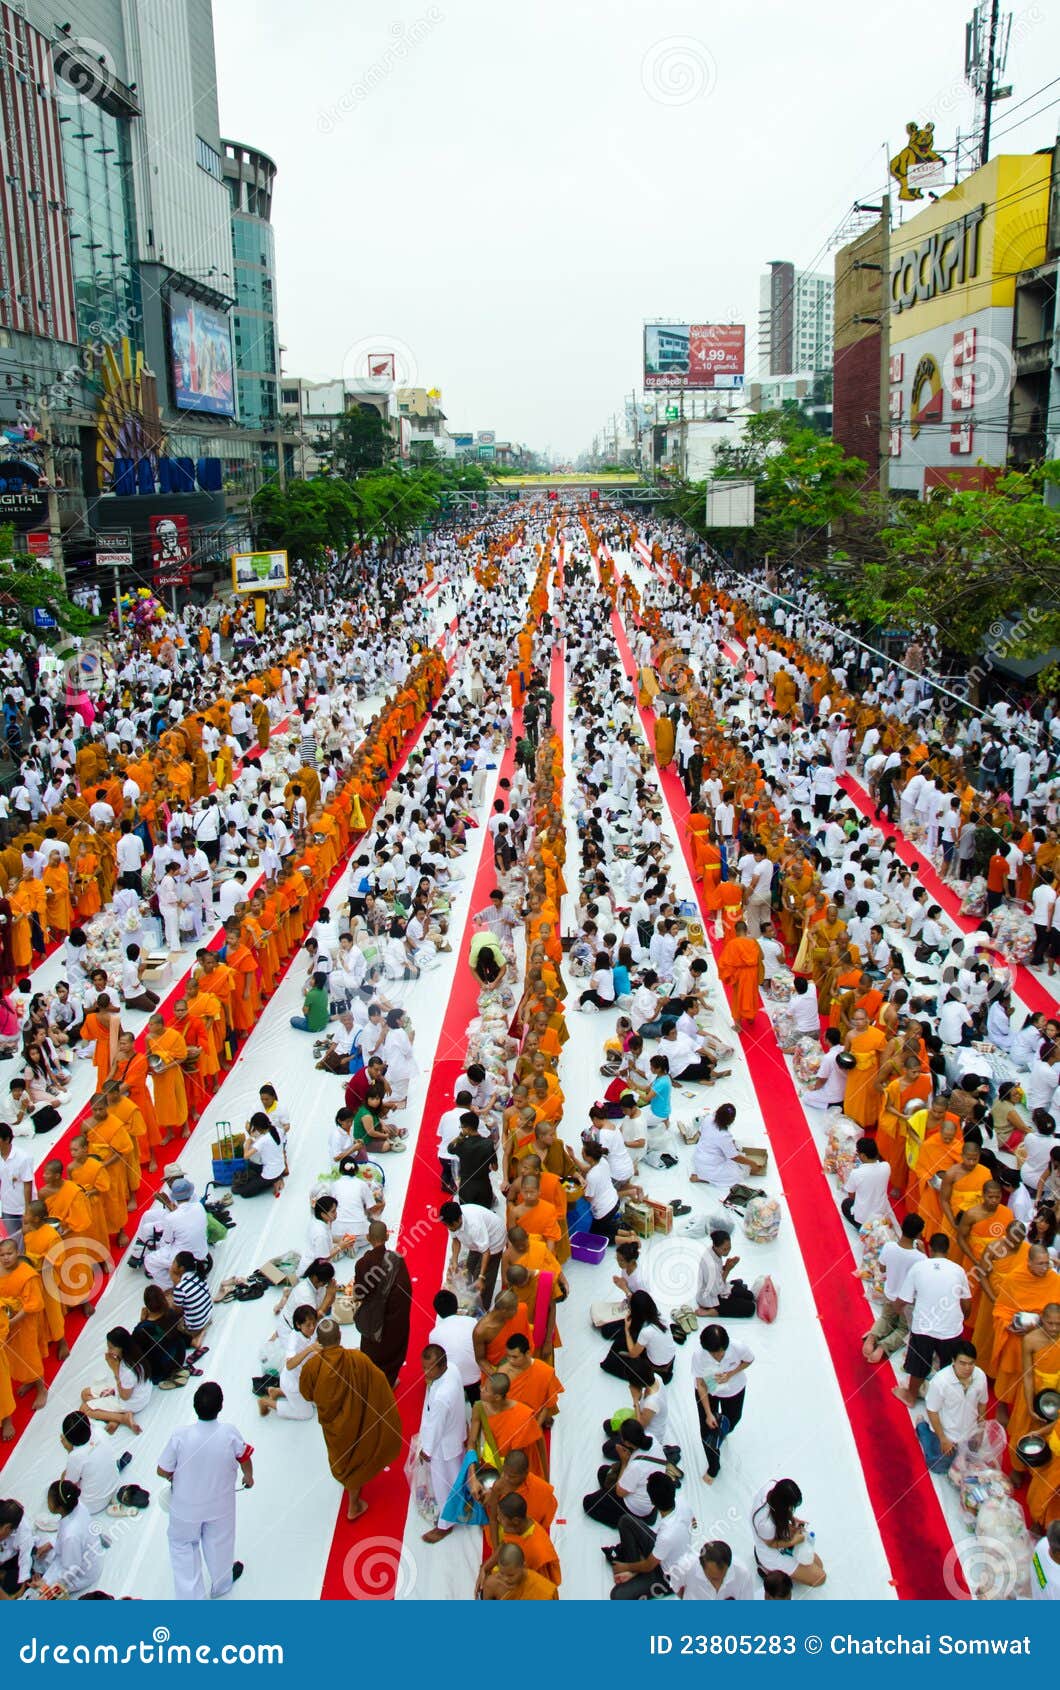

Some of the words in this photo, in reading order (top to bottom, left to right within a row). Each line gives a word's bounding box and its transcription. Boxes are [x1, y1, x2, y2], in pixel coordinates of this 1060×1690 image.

[890, 204, 984, 313] COCKPIT
[698, 349, 725, 361] 4.99
[702, 362, 712, 370] 10
[0, 494, 43, 505] GITAL
